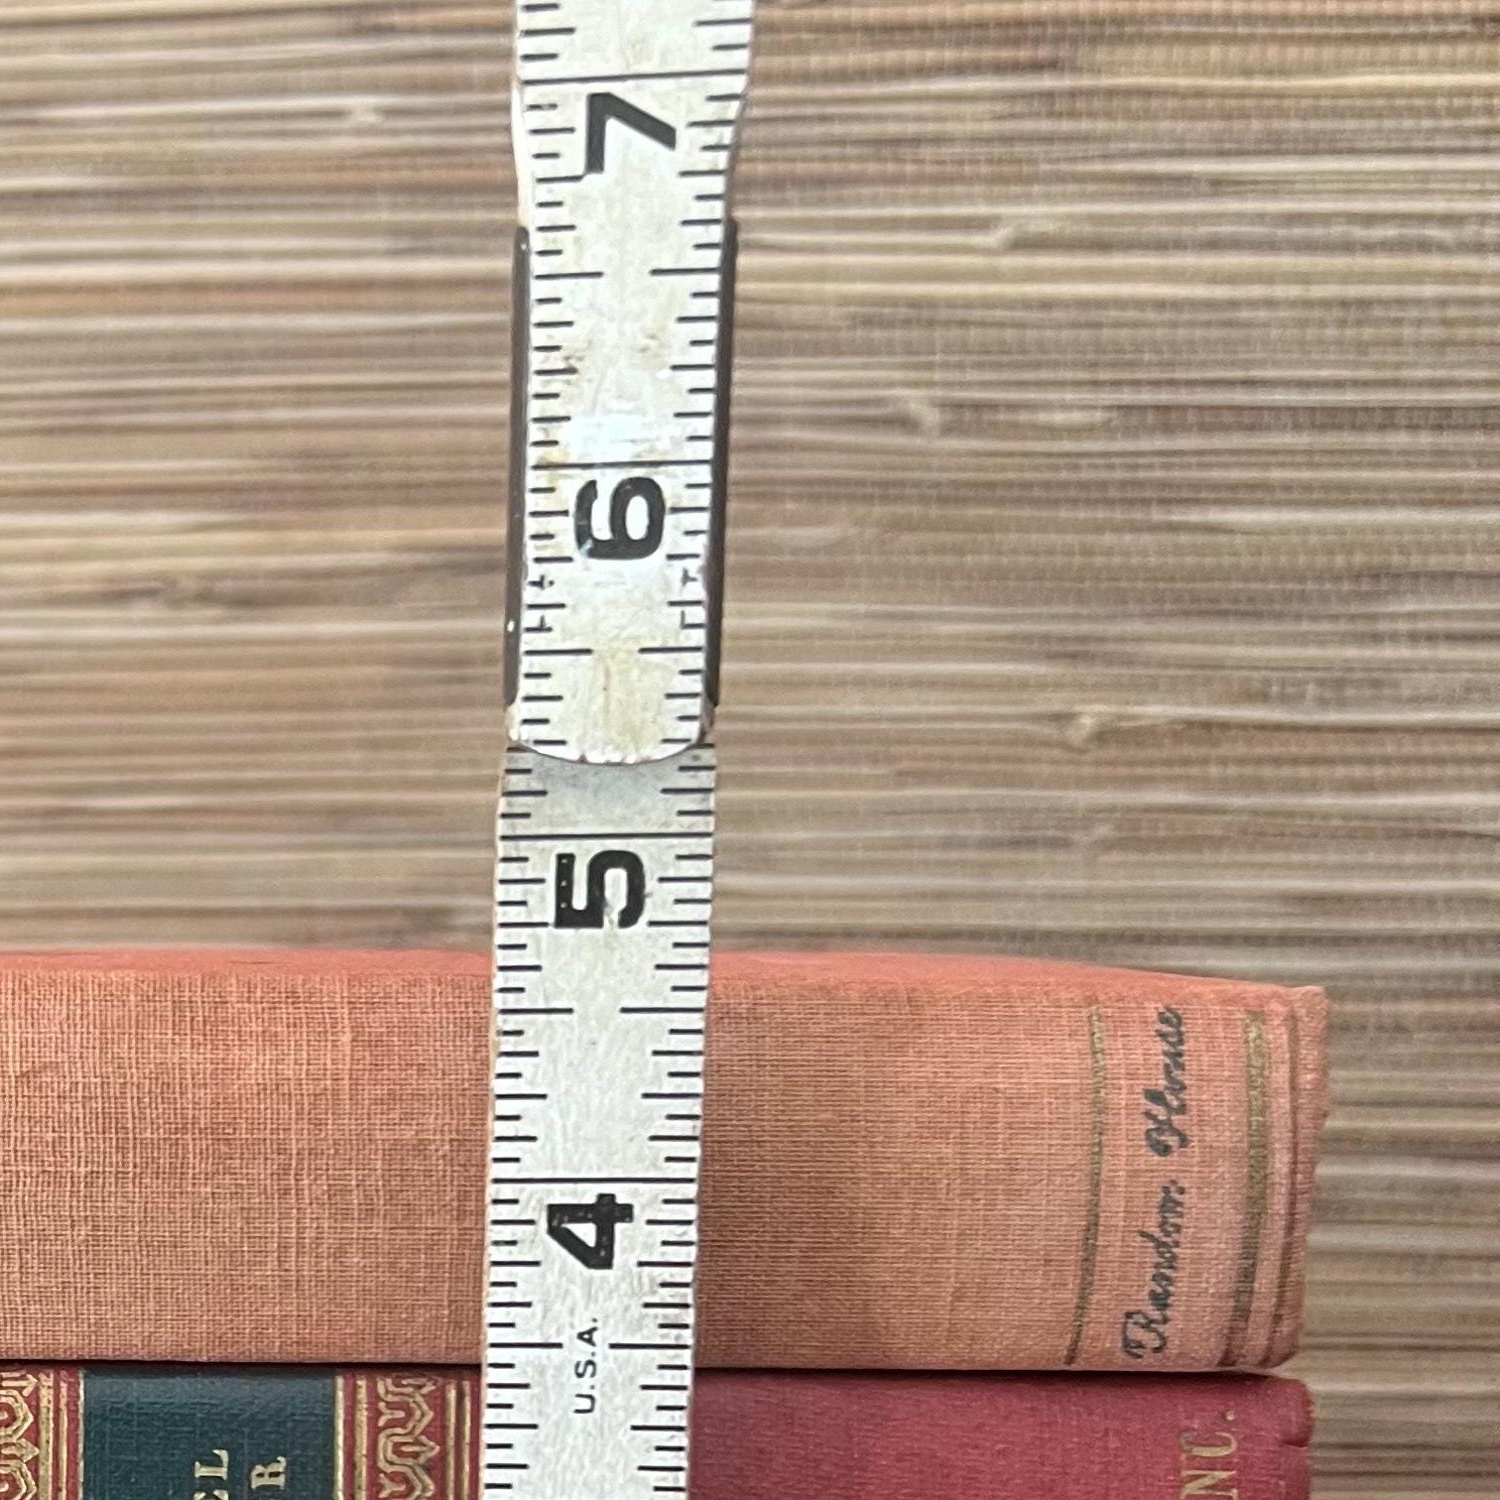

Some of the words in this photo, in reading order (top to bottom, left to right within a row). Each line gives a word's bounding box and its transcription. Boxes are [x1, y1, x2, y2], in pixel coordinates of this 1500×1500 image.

[586, 92, 677, 175] 7
[574, 475, 666, 561] 6
[553, 849, 646, 929] 5
[1143, 1004, 1194, 1157] House
[547, 1193, 635, 1270] 4
[1122, 1180, 1186, 1359] Random
[574, 1316, 598, 1414] U.S.A.
